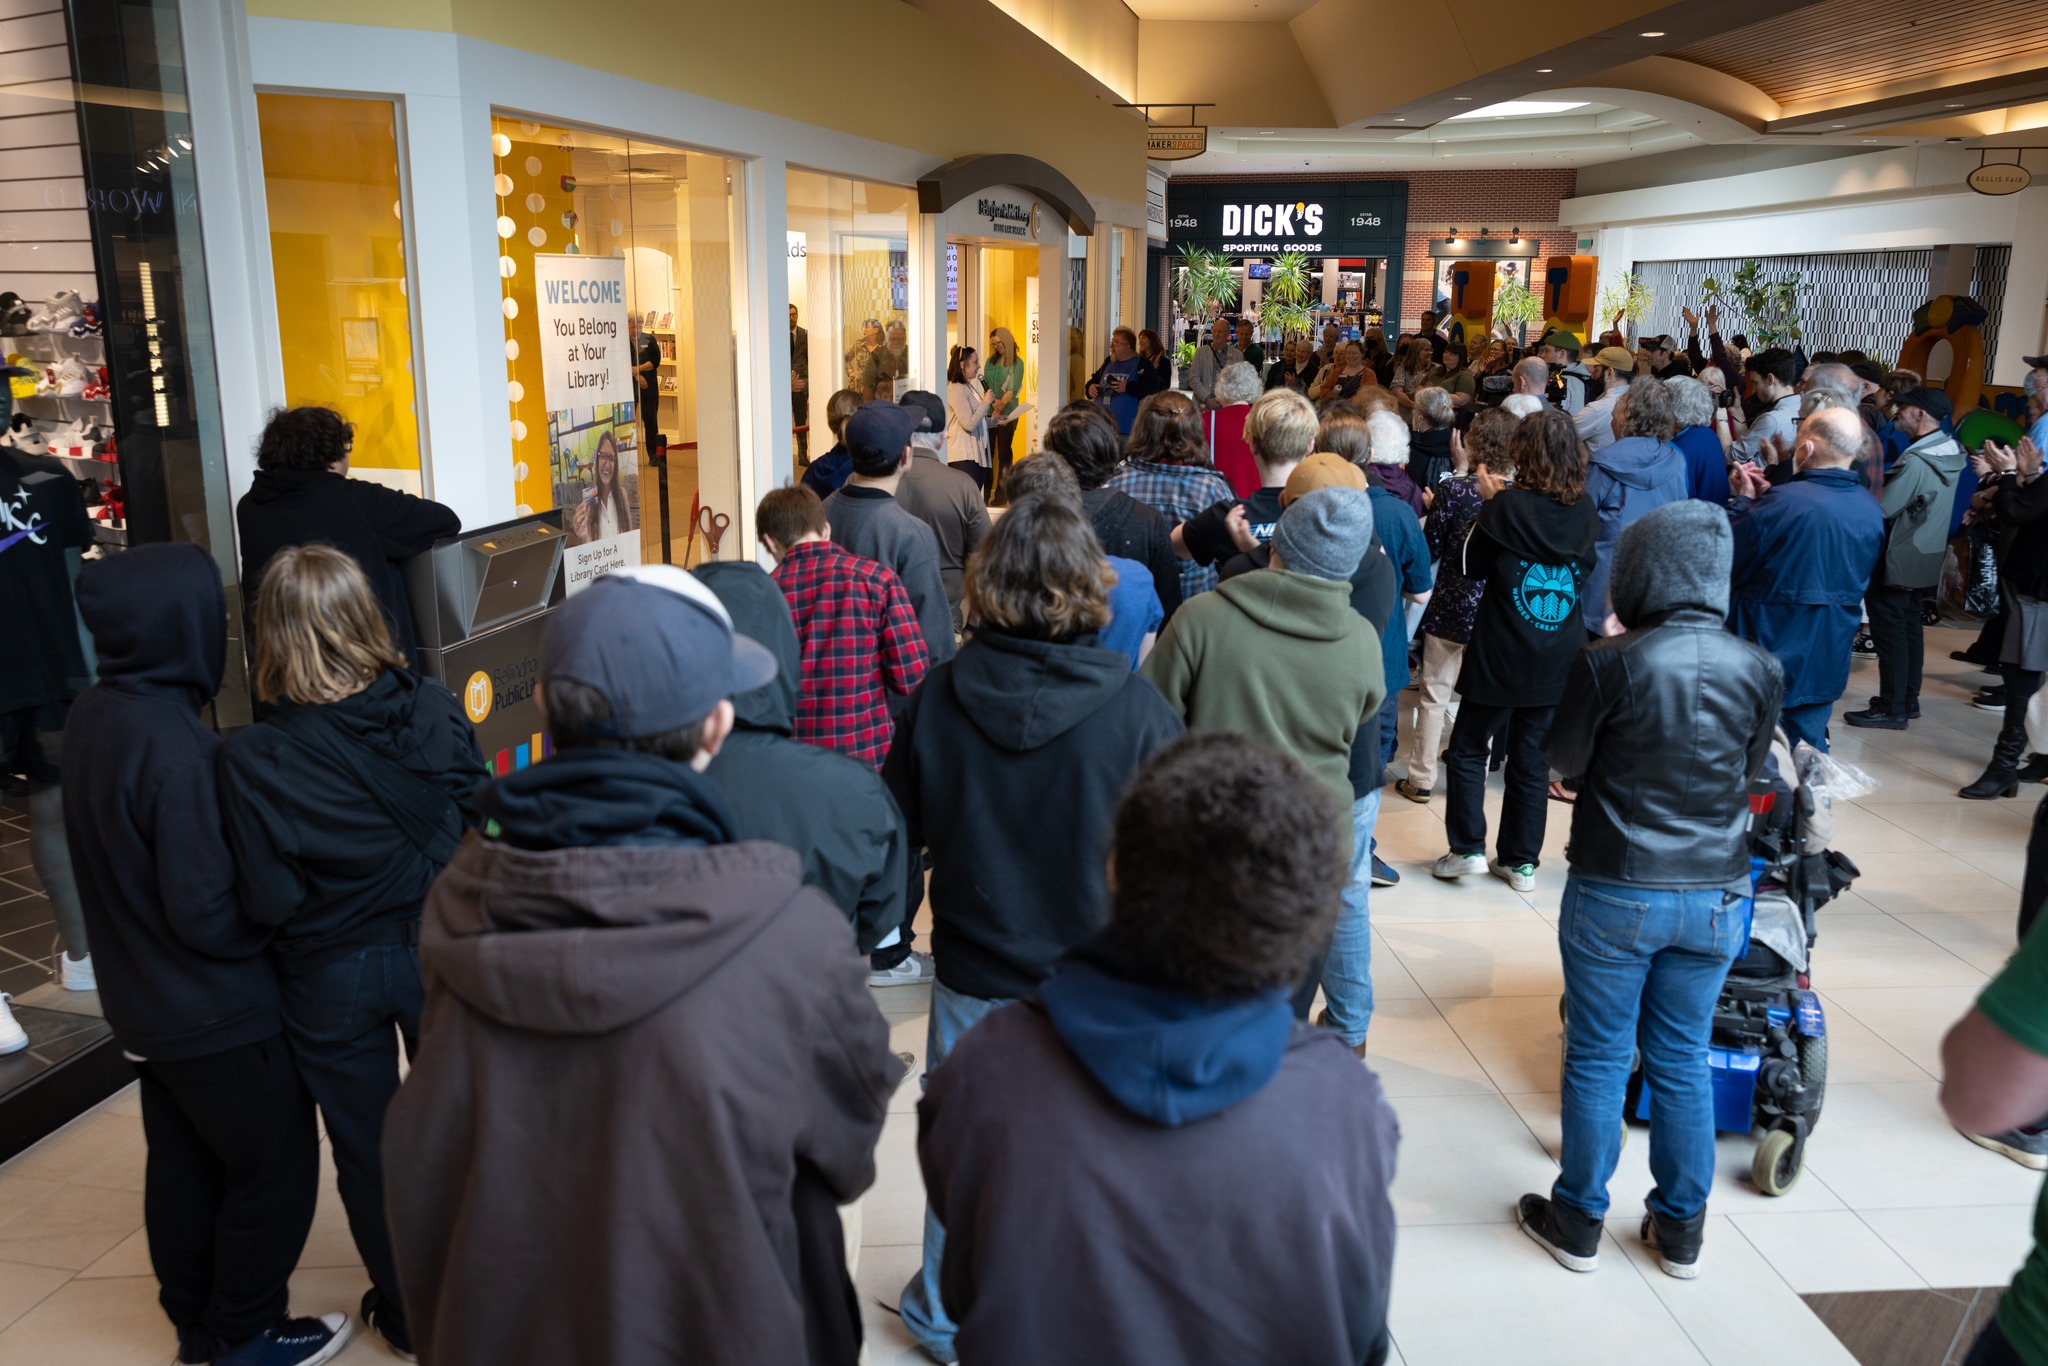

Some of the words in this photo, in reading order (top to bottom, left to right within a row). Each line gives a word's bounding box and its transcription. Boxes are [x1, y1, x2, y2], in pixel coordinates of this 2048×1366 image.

[1975, 175, 2002, 183] BELLIS
[1169, 218, 1198, 228] 1948
[1222, 203, 1324, 236] DICK'S
[1350, 217, 1381, 227] 1948
[1222, 243, 1279, 252] SPORTING
[1283, 243, 1323, 252] GOODS
[545, 280, 622, 304] WELCOME
[553, 318, 576, 337] You
[578, 317, 617, 339] Belong
[568, 345, 579, 362] at
[581, 343, 607, 361] Your
[567, 368, 610, 391] Library!
[577, 554, 593, 565] Sign
[592, 549, 603, 560] Up
[603, 546, 613, 557] for
[613, 544, 619, 555] A
[570, 570, 593, 583] Library
[593, 562, 609, 575] Card
[609, 558, 626, 570] Here.
[1512, 587, 1531, 621] WANDER
[1534, 621, 1560, 632] CREAT
[493, 656, 539, 688] Bellingha
